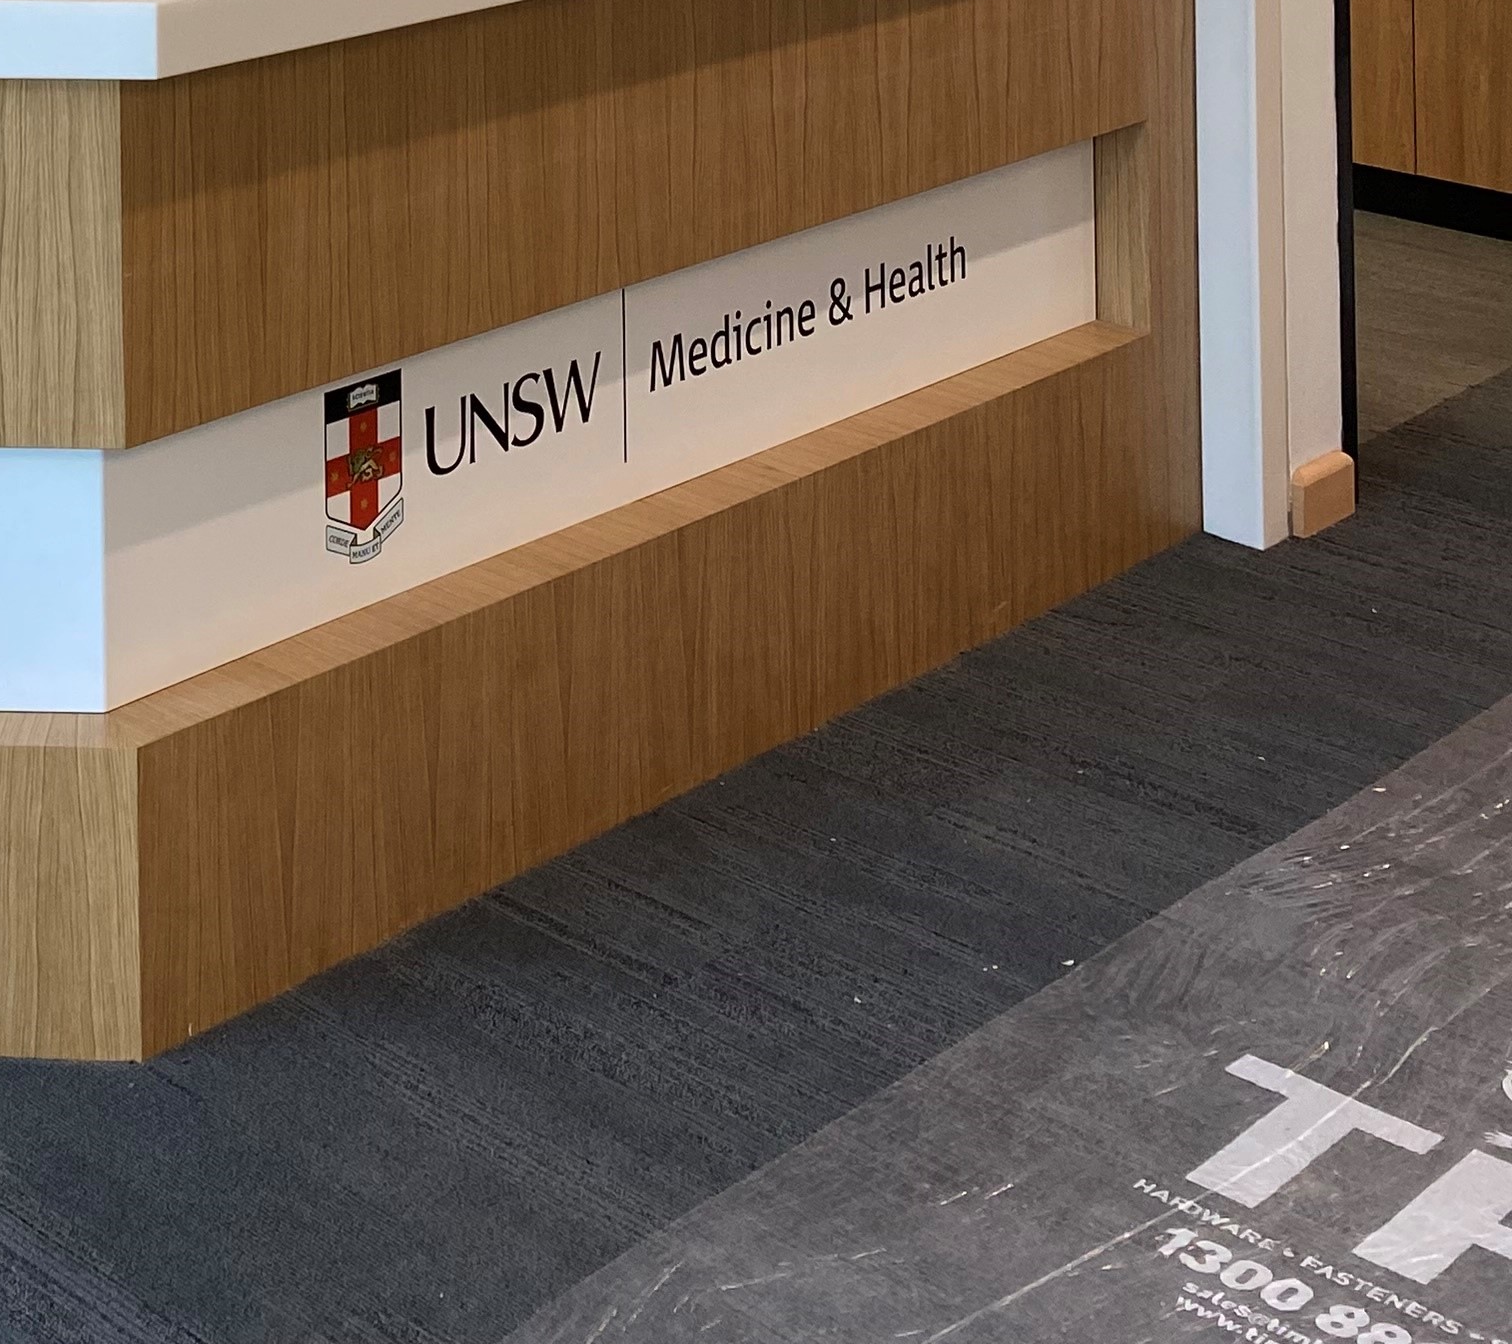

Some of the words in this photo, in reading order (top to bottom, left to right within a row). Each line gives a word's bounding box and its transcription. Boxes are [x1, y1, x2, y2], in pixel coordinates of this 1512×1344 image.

[425, 351, 601, 476] UNSW
[650, 300, 816, 393] Medicine
[828, 277, 854, 326] &
[865, 236, 966, 314] Health
[1133, 1178, 1281, 1251] HARDWARE
[1300, 1255, 1463, 1335] FASTENERS
[1155, 1227, 1314, 1311] 1300
